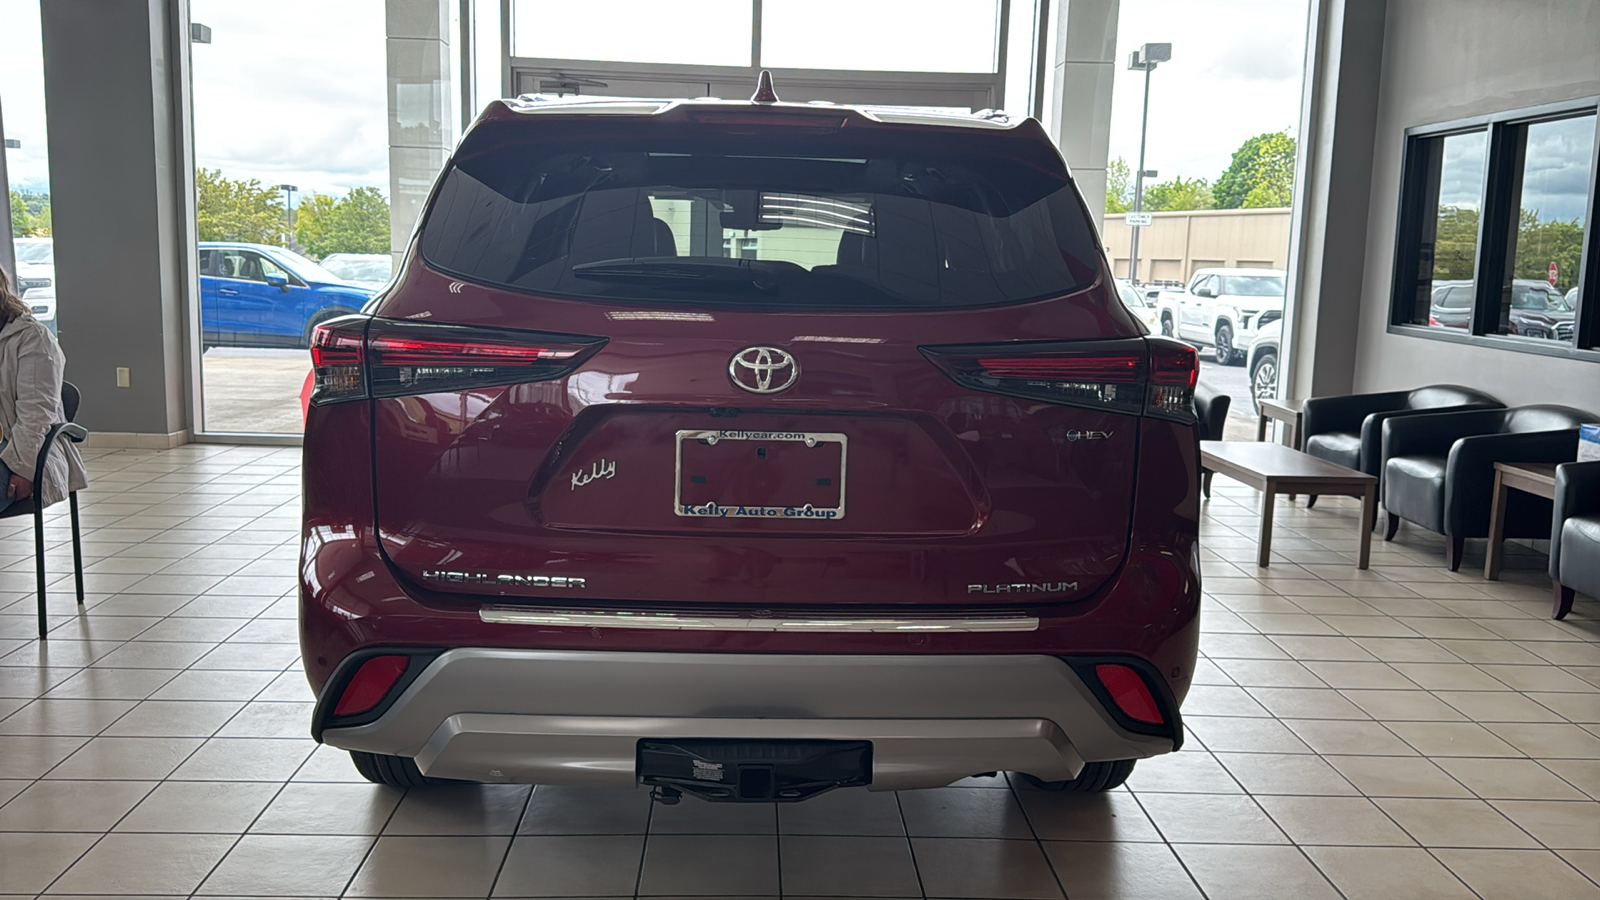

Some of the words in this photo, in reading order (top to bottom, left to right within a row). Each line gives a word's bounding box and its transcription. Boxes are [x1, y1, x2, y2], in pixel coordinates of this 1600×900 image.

[719, 430, 806, 440] Kellycar.com
[571, 458, 616, 491] Kelly
[683, 505, 729, 518] Kelly
[735, 506, 777, 517] Auto
[784, 507, 837, 519] Group
[422, 569, 586, 588] HIGHLANDER
[967, 581, 1078, 594] PLATINUM
